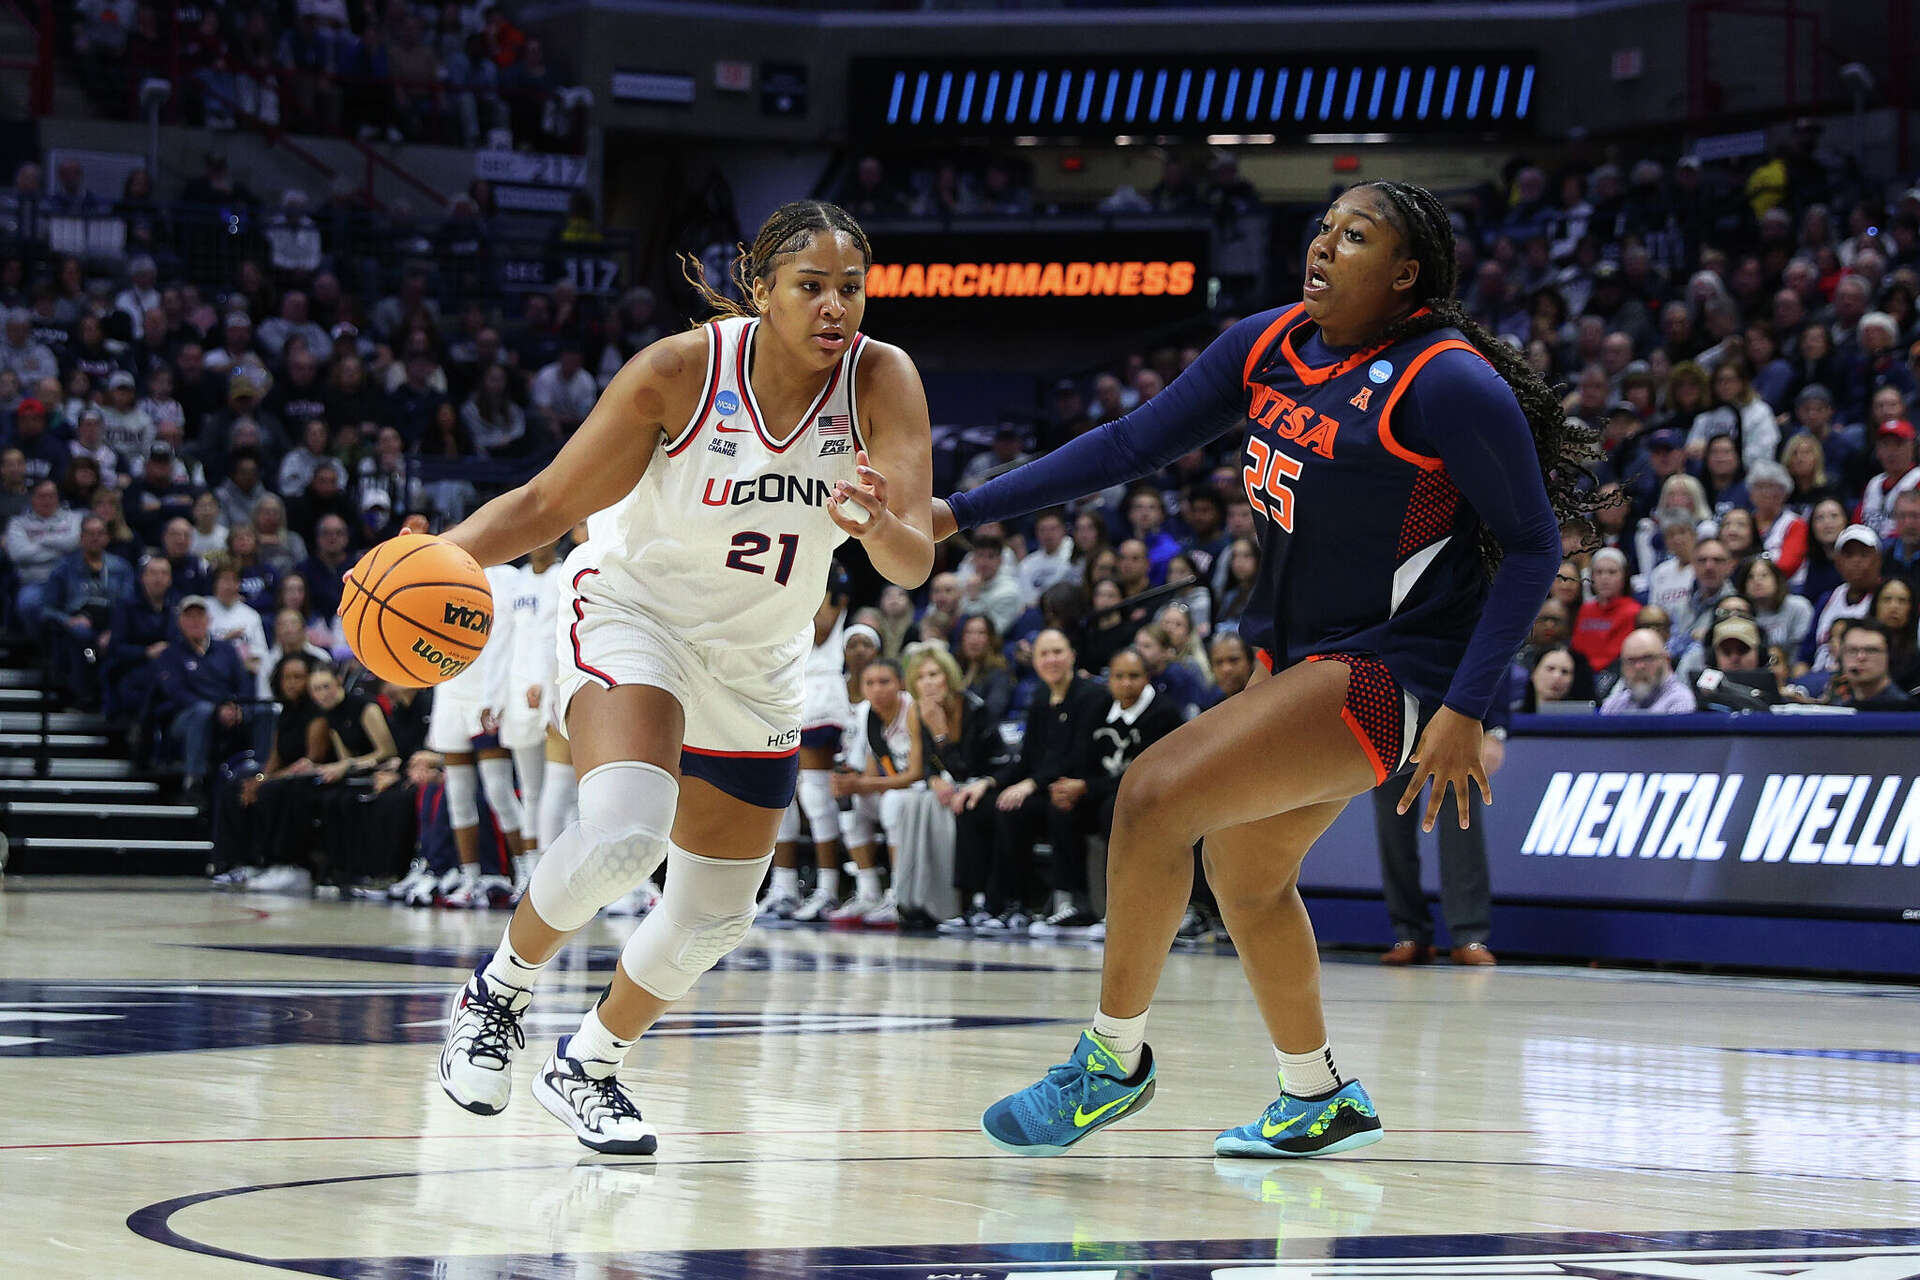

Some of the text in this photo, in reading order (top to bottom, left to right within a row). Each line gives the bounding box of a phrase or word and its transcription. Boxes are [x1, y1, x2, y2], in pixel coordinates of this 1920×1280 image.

[565, 258, 619, 292] 117
[1371, 367, 1389, 381] NCAA
[716, 399, 736, 411] NCAA
[1247, 381, 1340, 460] UTSA
[708, 444, 737, 457] CHANGE
[711, 437, 738, 450] BE THE
[818, 445, 852, 457] EAST
[823, 439, 847, 447] BIG
[1243, 435, 1303, 534] 25
[725, 531, 799, 587] 21
[443, 602, 492, 636] NCAA
[411, 637, 470, 678] ilson
[1520, 772, 1744, 861] MENTAL
